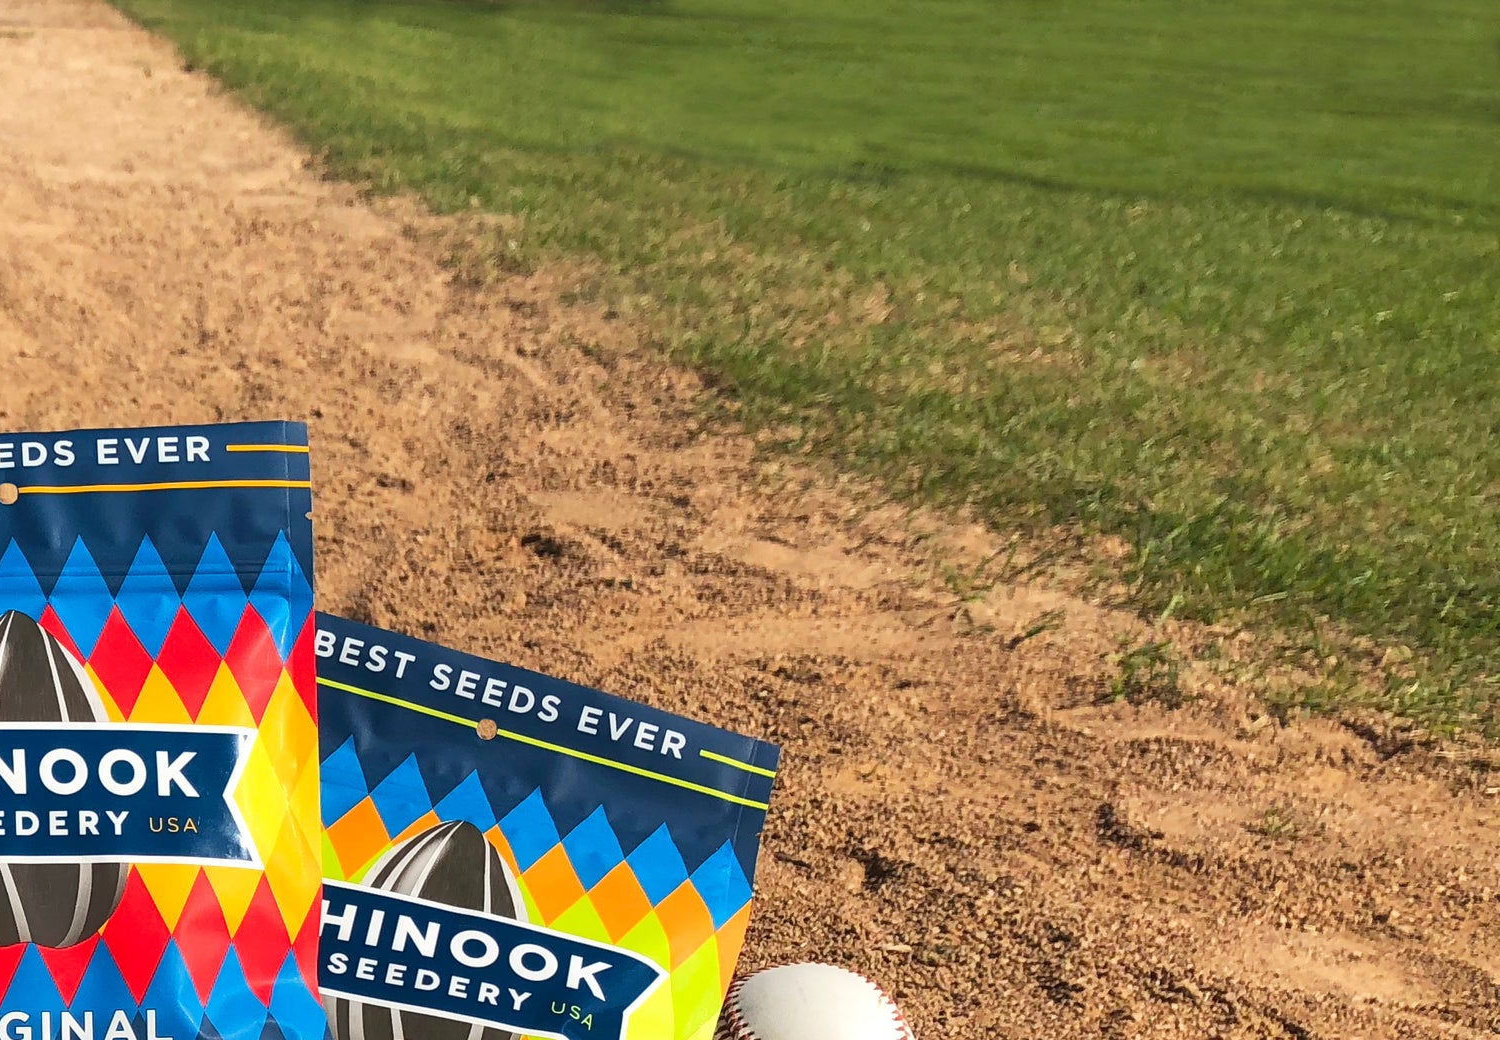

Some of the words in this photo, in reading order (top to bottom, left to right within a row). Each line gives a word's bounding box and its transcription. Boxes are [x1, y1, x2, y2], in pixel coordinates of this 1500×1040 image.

[97, 435, 212, 466] EVER
[315, 629, 418, 678] BEST
[429, 664, 561, 722] SEEDS
[576, 706, 687, 759] EVER
[149, 816, 198, 834] USA
[318, 899, 613, 1002] HINOOK
[327, 952, 532, 1012] SEEDERY
[551, 1000, 594, 1031] USA
